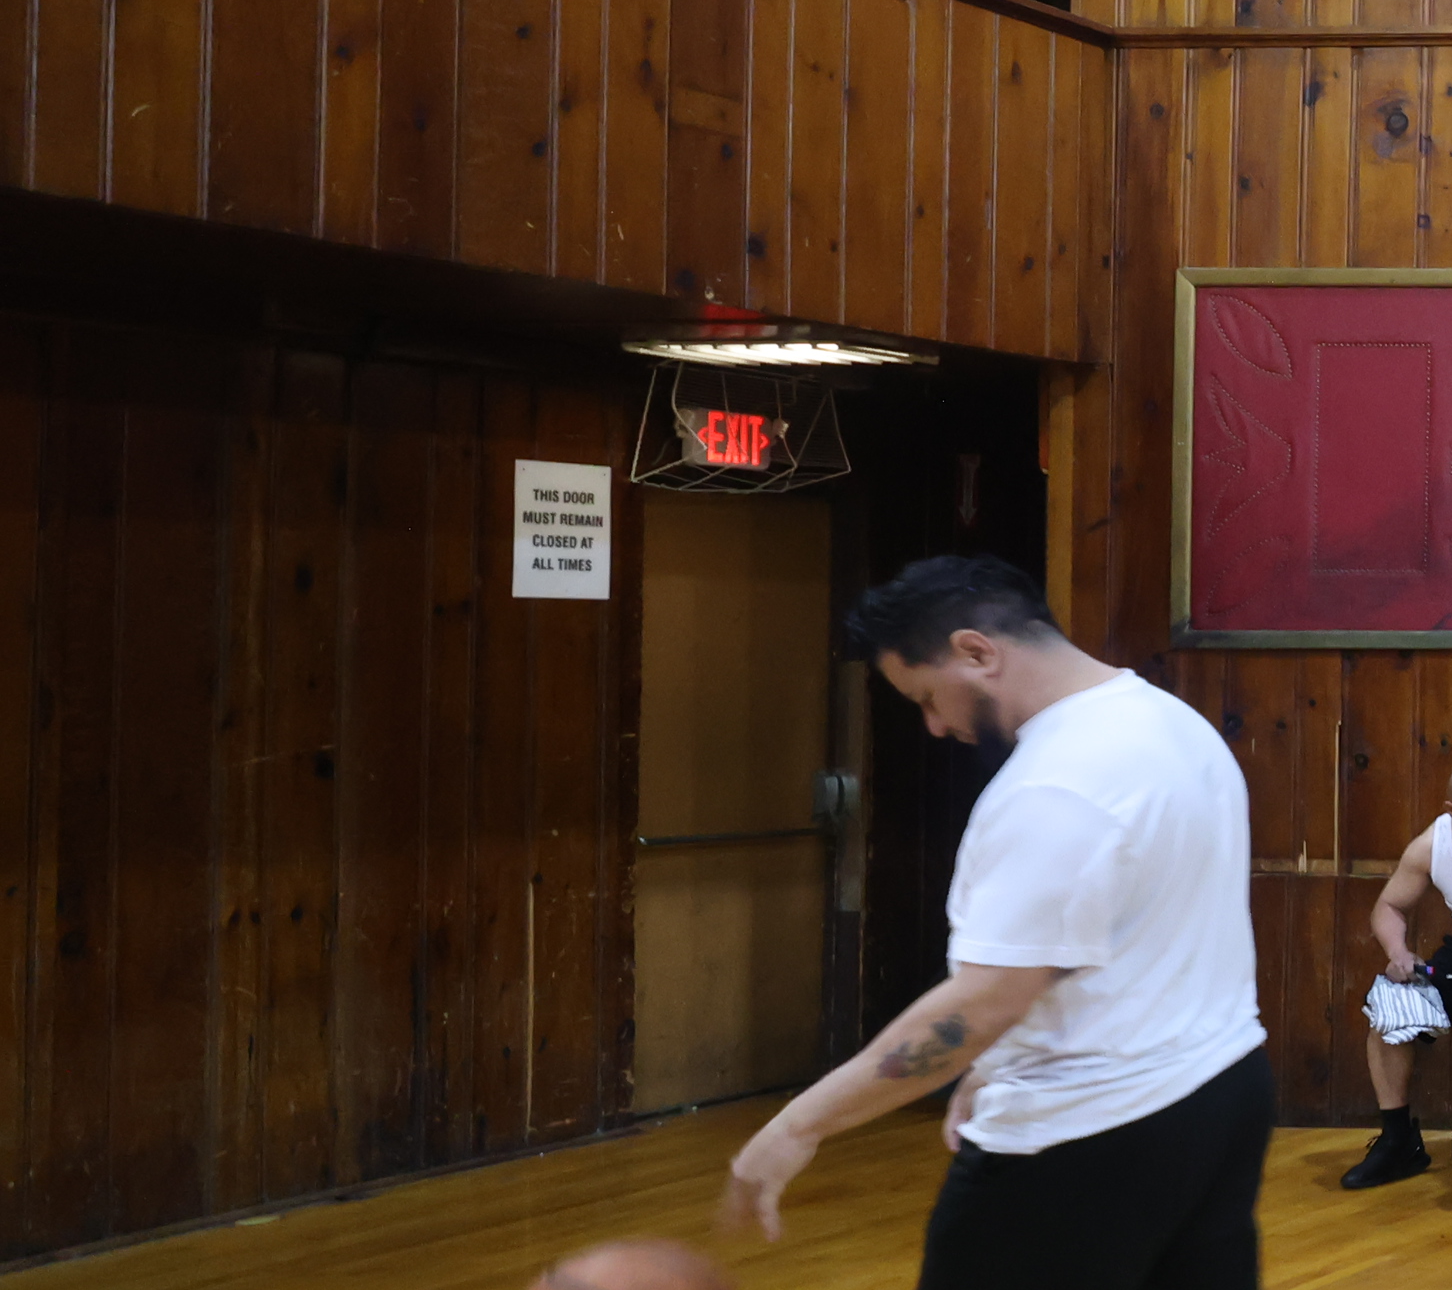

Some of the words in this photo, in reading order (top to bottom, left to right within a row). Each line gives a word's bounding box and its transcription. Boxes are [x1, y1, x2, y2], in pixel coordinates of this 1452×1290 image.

[707, 410, 765, 466] EXIT
[533, 489, 559, 502] THIS
[563, 491, 594, 504] DOOR
[523, 511, 556, 524] MUST
[560, 513, 603, 527] REMAIN
[532, 534, 577, 548] CLOSED
[580, 537, 594, 549] AT
[532, 557, 554, 570] ALL
[558, 558, 592, 571] TIMES
